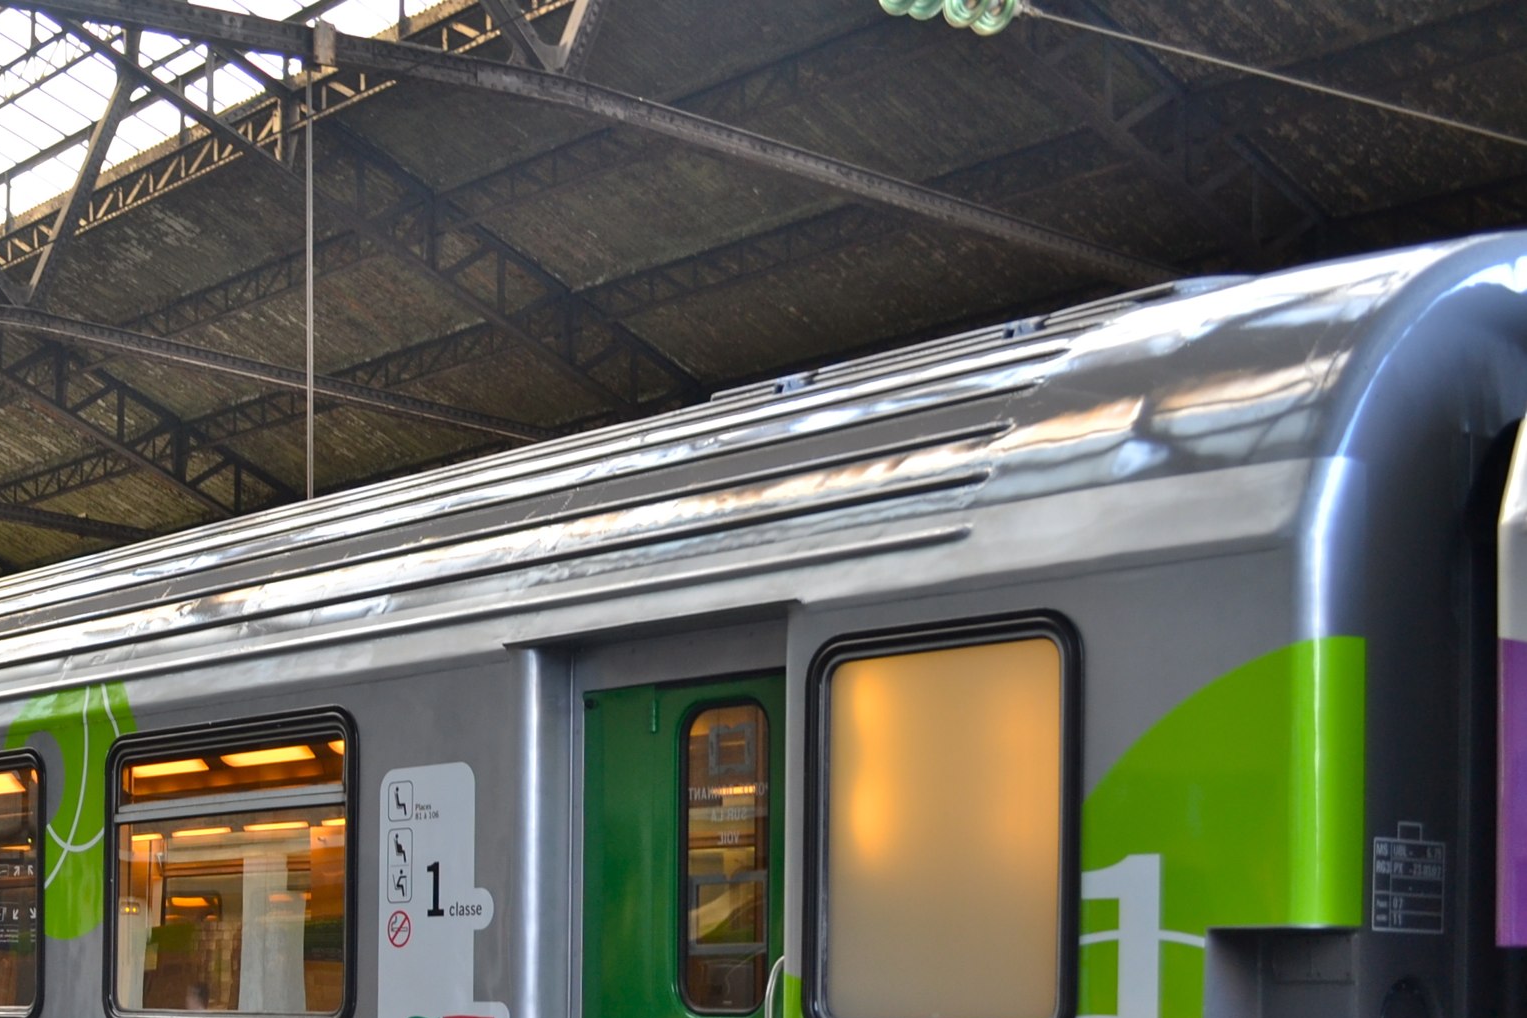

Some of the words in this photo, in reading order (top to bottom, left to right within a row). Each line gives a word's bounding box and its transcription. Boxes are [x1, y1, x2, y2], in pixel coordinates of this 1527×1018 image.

[415, 803, 432, 811] Places
[427, 861, 444, 917] 1
[449, 901, 483, 917] classe
